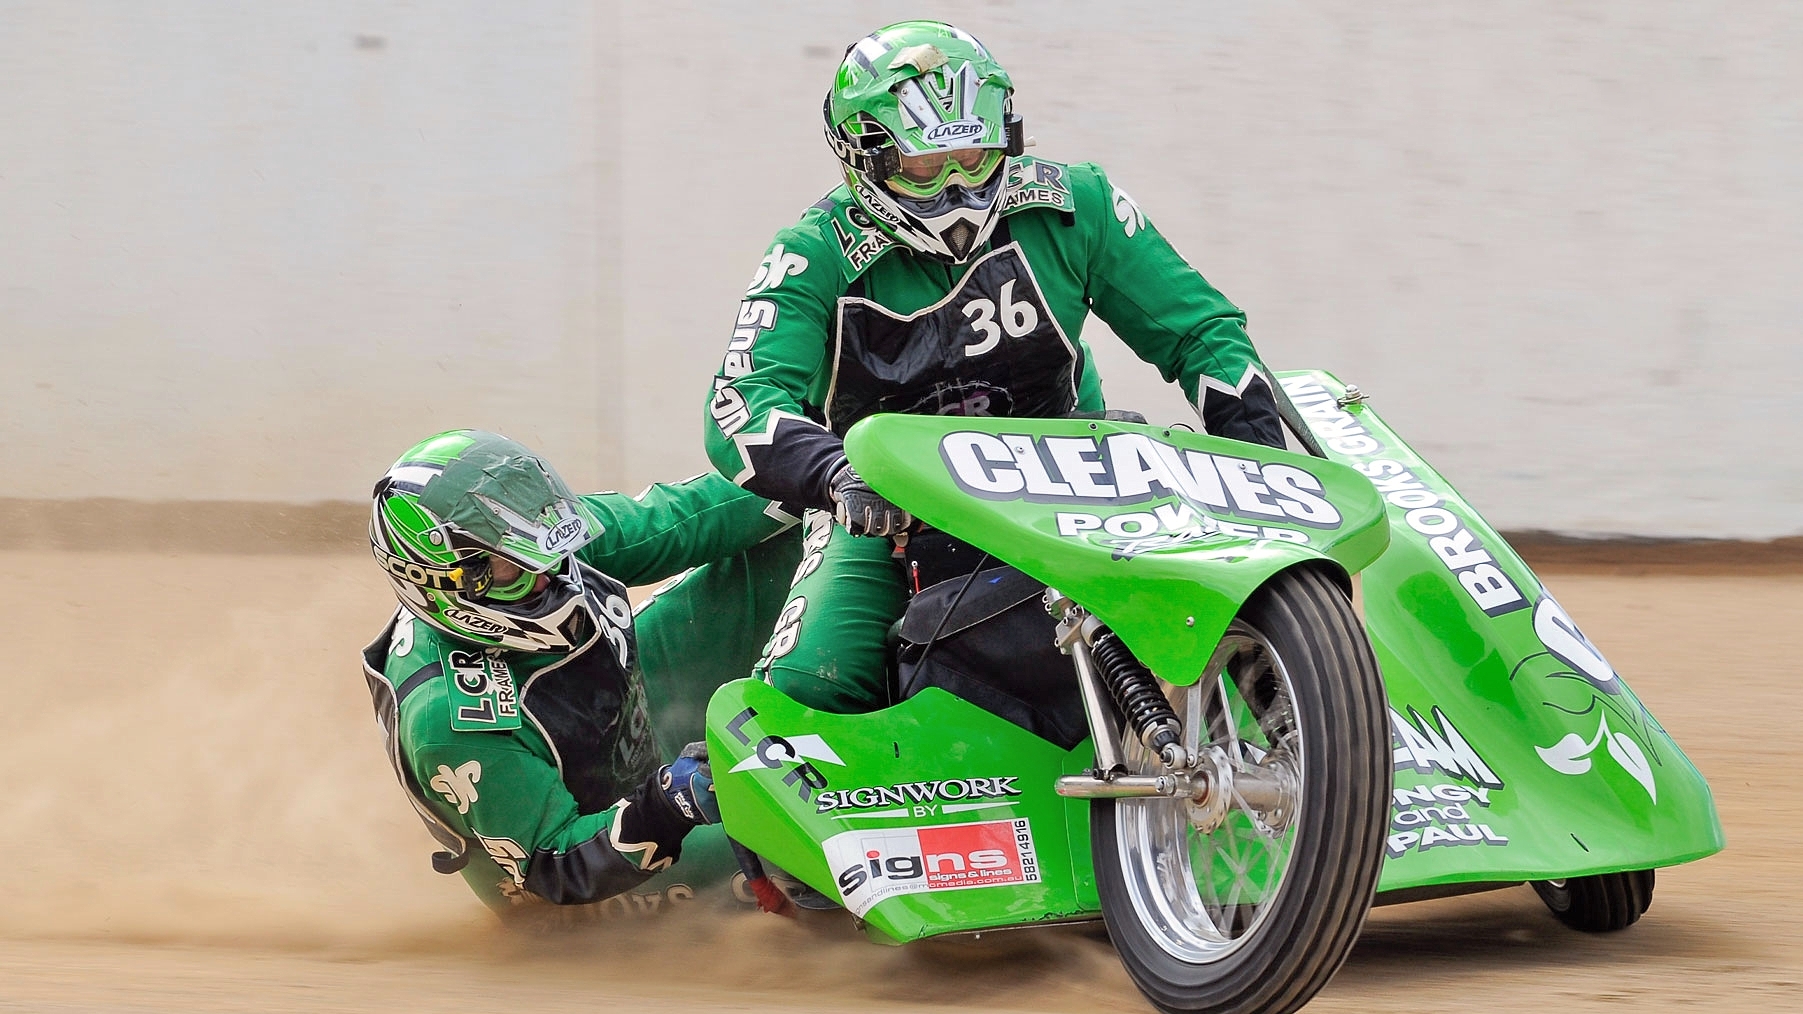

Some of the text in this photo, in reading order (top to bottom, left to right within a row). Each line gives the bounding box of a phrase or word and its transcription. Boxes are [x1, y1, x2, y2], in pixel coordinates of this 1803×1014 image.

[934, 124, 982, 138] LAZER
[860, 189, 899, 222] LAZER
[1004, 189, 1064, 208] AMES
[849, 233, 892, 270] FRA
[961, 278, 1039, 357] 36
[939, 431, 1344, 529] CLEAVES
[1279, 374, 1531, 618] BROOKS GRAIN
[549, 518, 582, 545] LAZER
[450, 609, 507, 633] LAZER
[591, 589, 631, 669] 36
[450, 650, 495, 722] LCR
[725, 706, 828, 803] LCR
[816, 776, 1022, 813] SIGNWORK
[913, 804, 937, 818] BY
[1392, 784, 1490, 812] NGY
[1392, 802, 1470, 831] and
[1386, 824, 1509, 859] PAUL
[838, 849, 1008, 897] signs
[929, 872, 966, 882] signs
[980, 869, 1012, 877] lines
